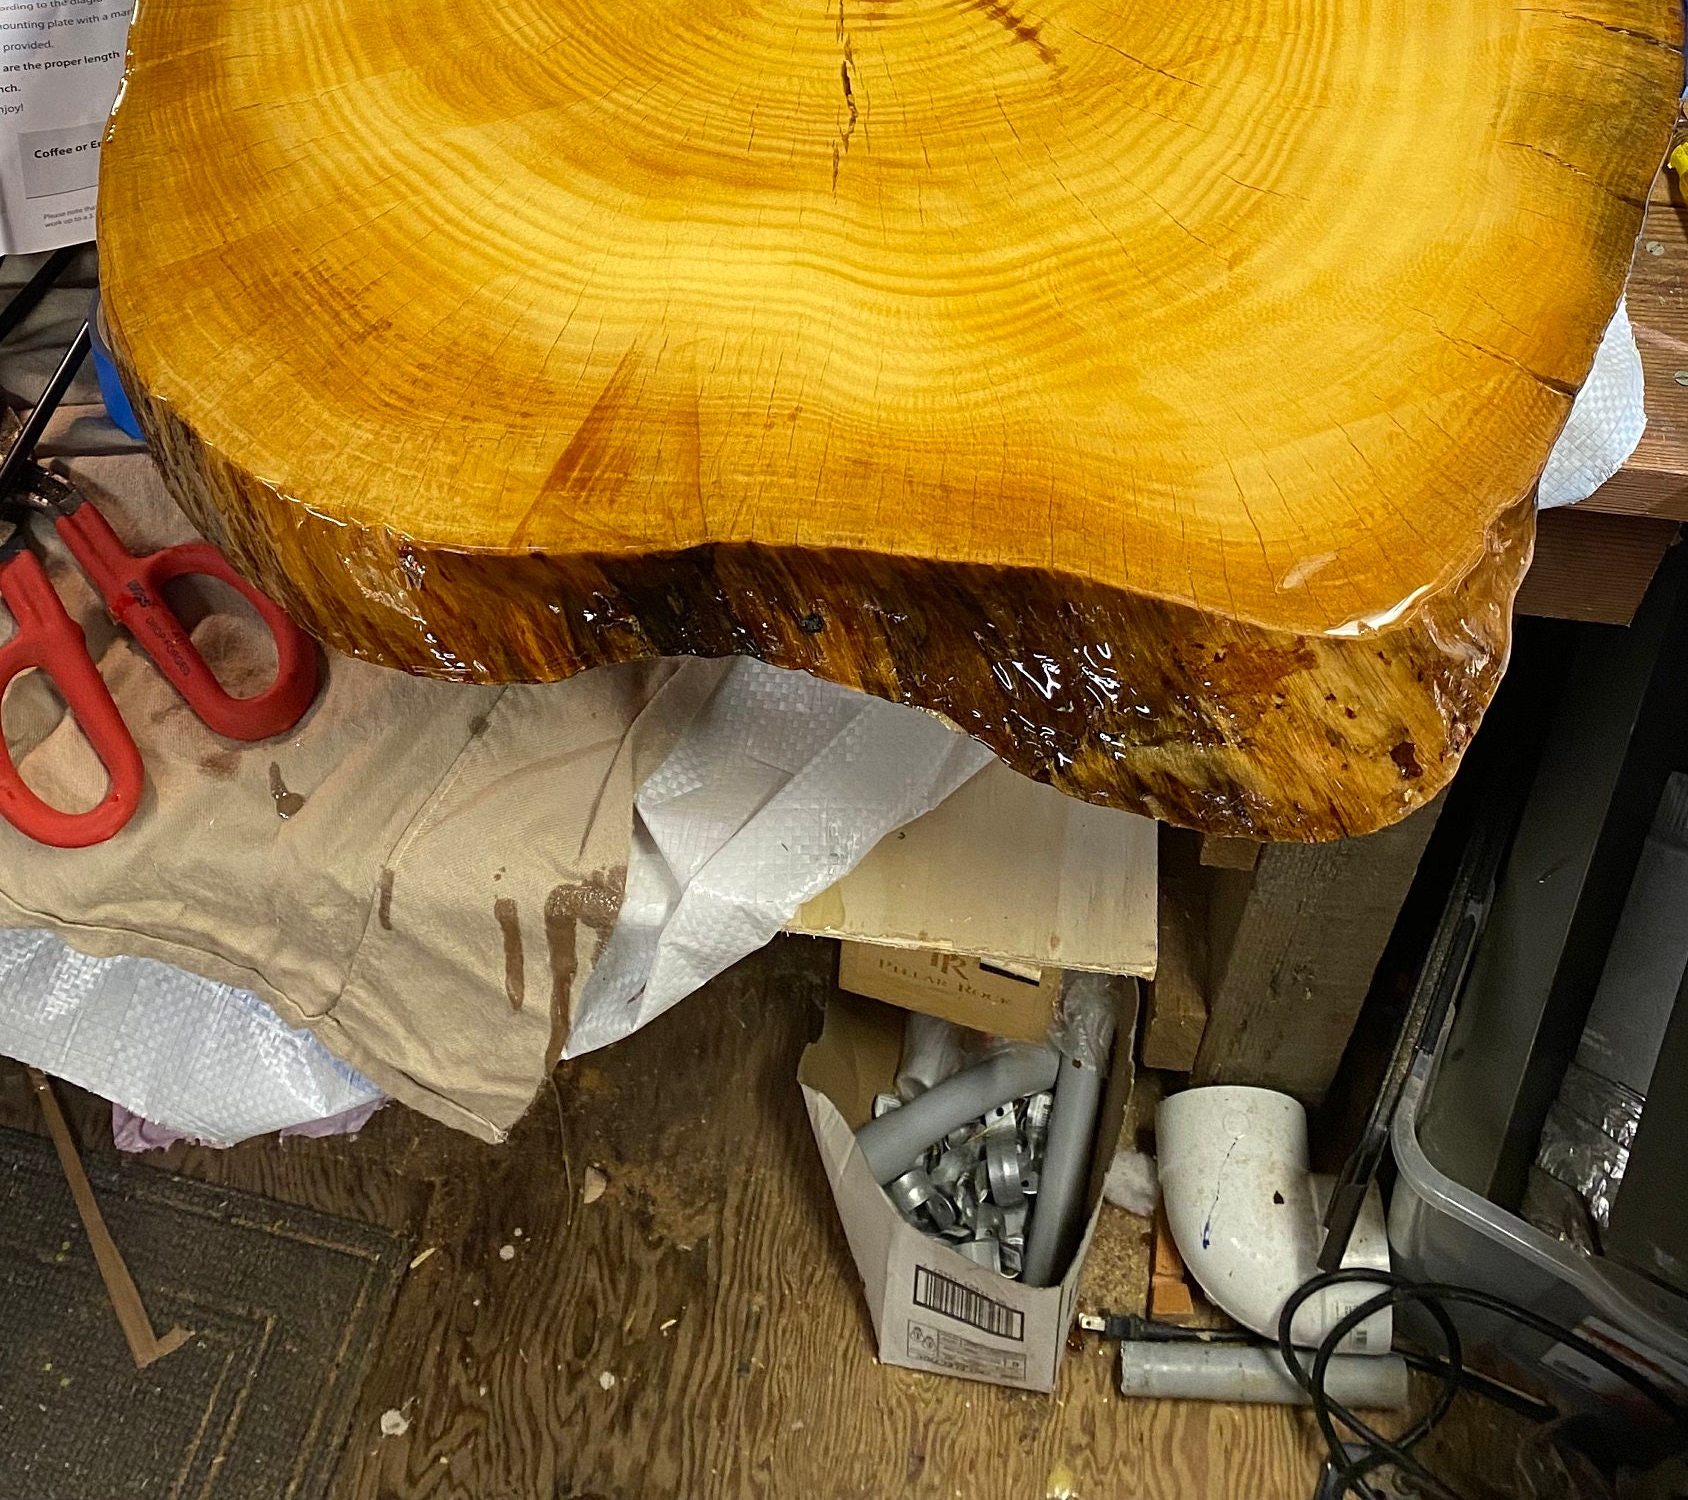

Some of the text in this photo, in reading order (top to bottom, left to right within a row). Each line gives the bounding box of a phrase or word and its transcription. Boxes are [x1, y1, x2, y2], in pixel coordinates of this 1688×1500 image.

[36, 1, 48, 9] to
[47, 18, 74, 30] plate
[76, 14, 100, 25] with
[3, 40, 54, 53] provided.
[3, 50, 121, 73] are the proper length
[34, 146, 73, 159] Coffee
[75, 143, 88, 152] or
[43, 211, 66, 220] Please
[67, 207, 83, 216] note
